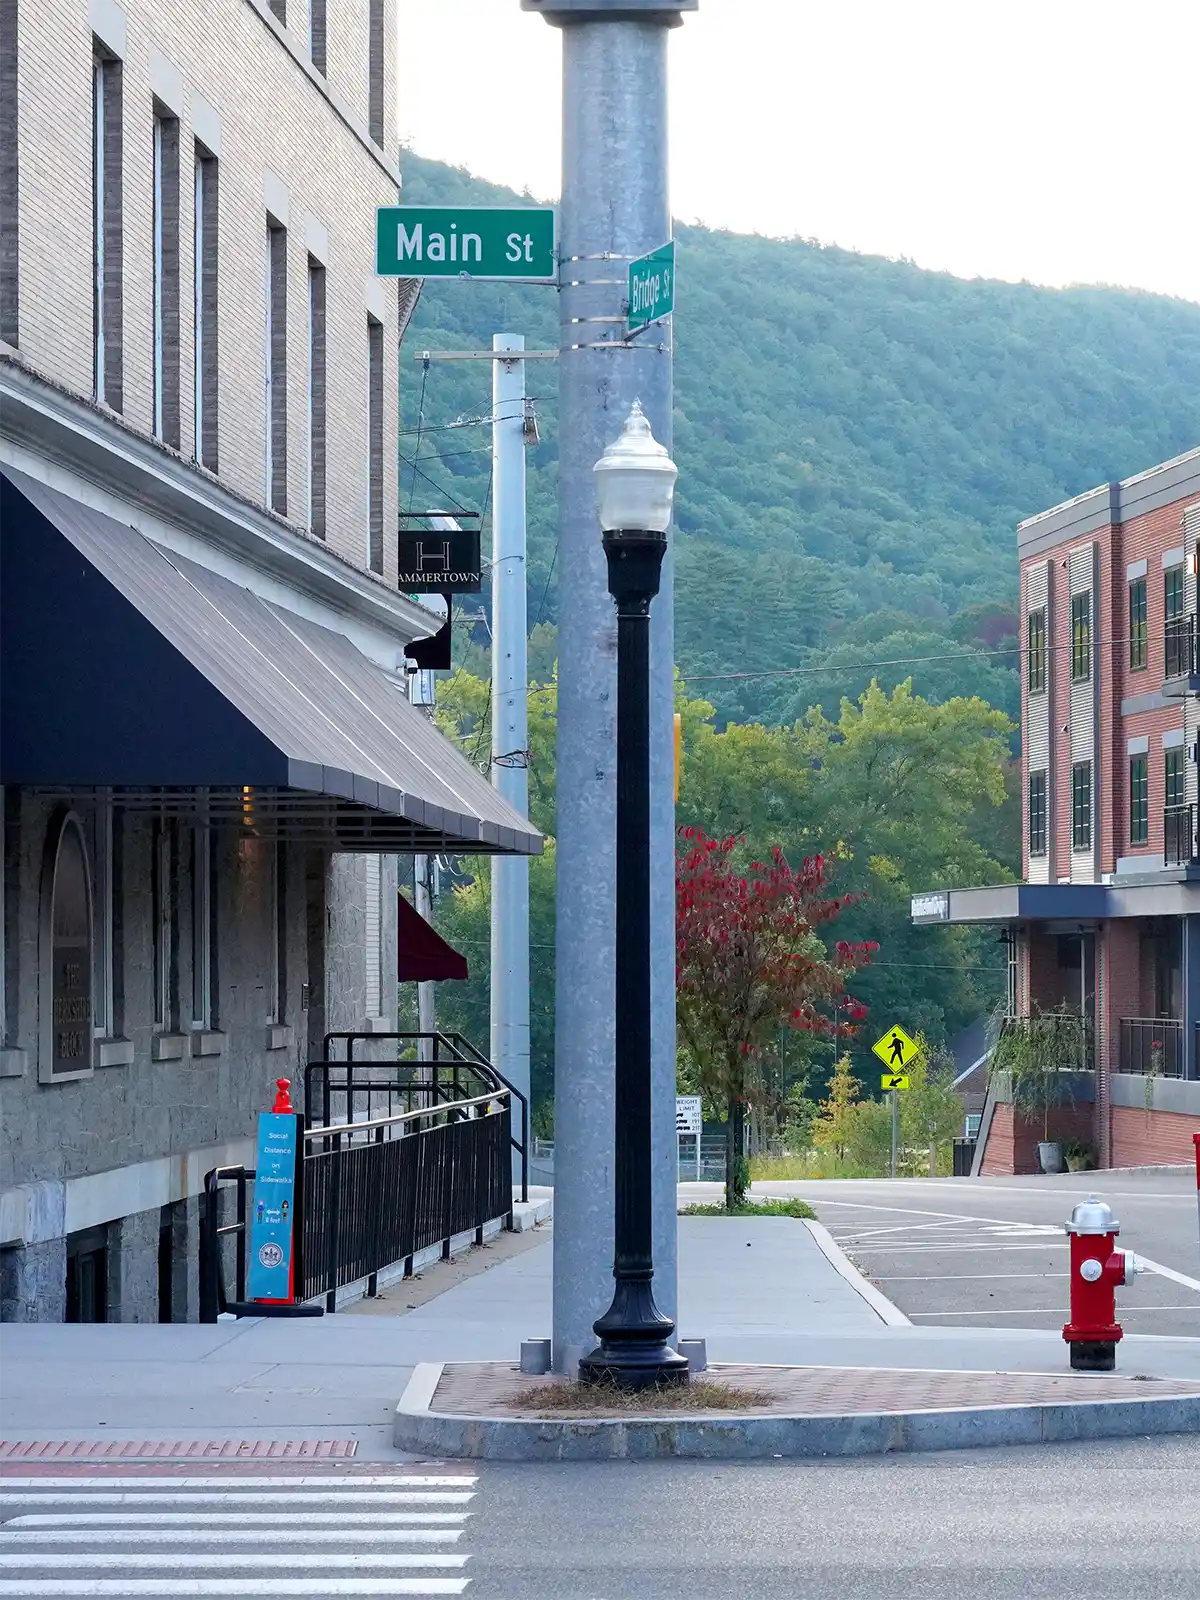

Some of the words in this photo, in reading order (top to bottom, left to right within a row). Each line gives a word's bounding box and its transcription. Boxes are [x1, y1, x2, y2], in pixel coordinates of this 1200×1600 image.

[397, 223, 482, 262] Main
[505, 232, 534, 262] St
[632, 268, 660, 318] Bridge
[663, 267, 670, 299] St
[398, 572, 480, 583] AMMERTOWN
[264, 1146, 292, 1154] Distance
